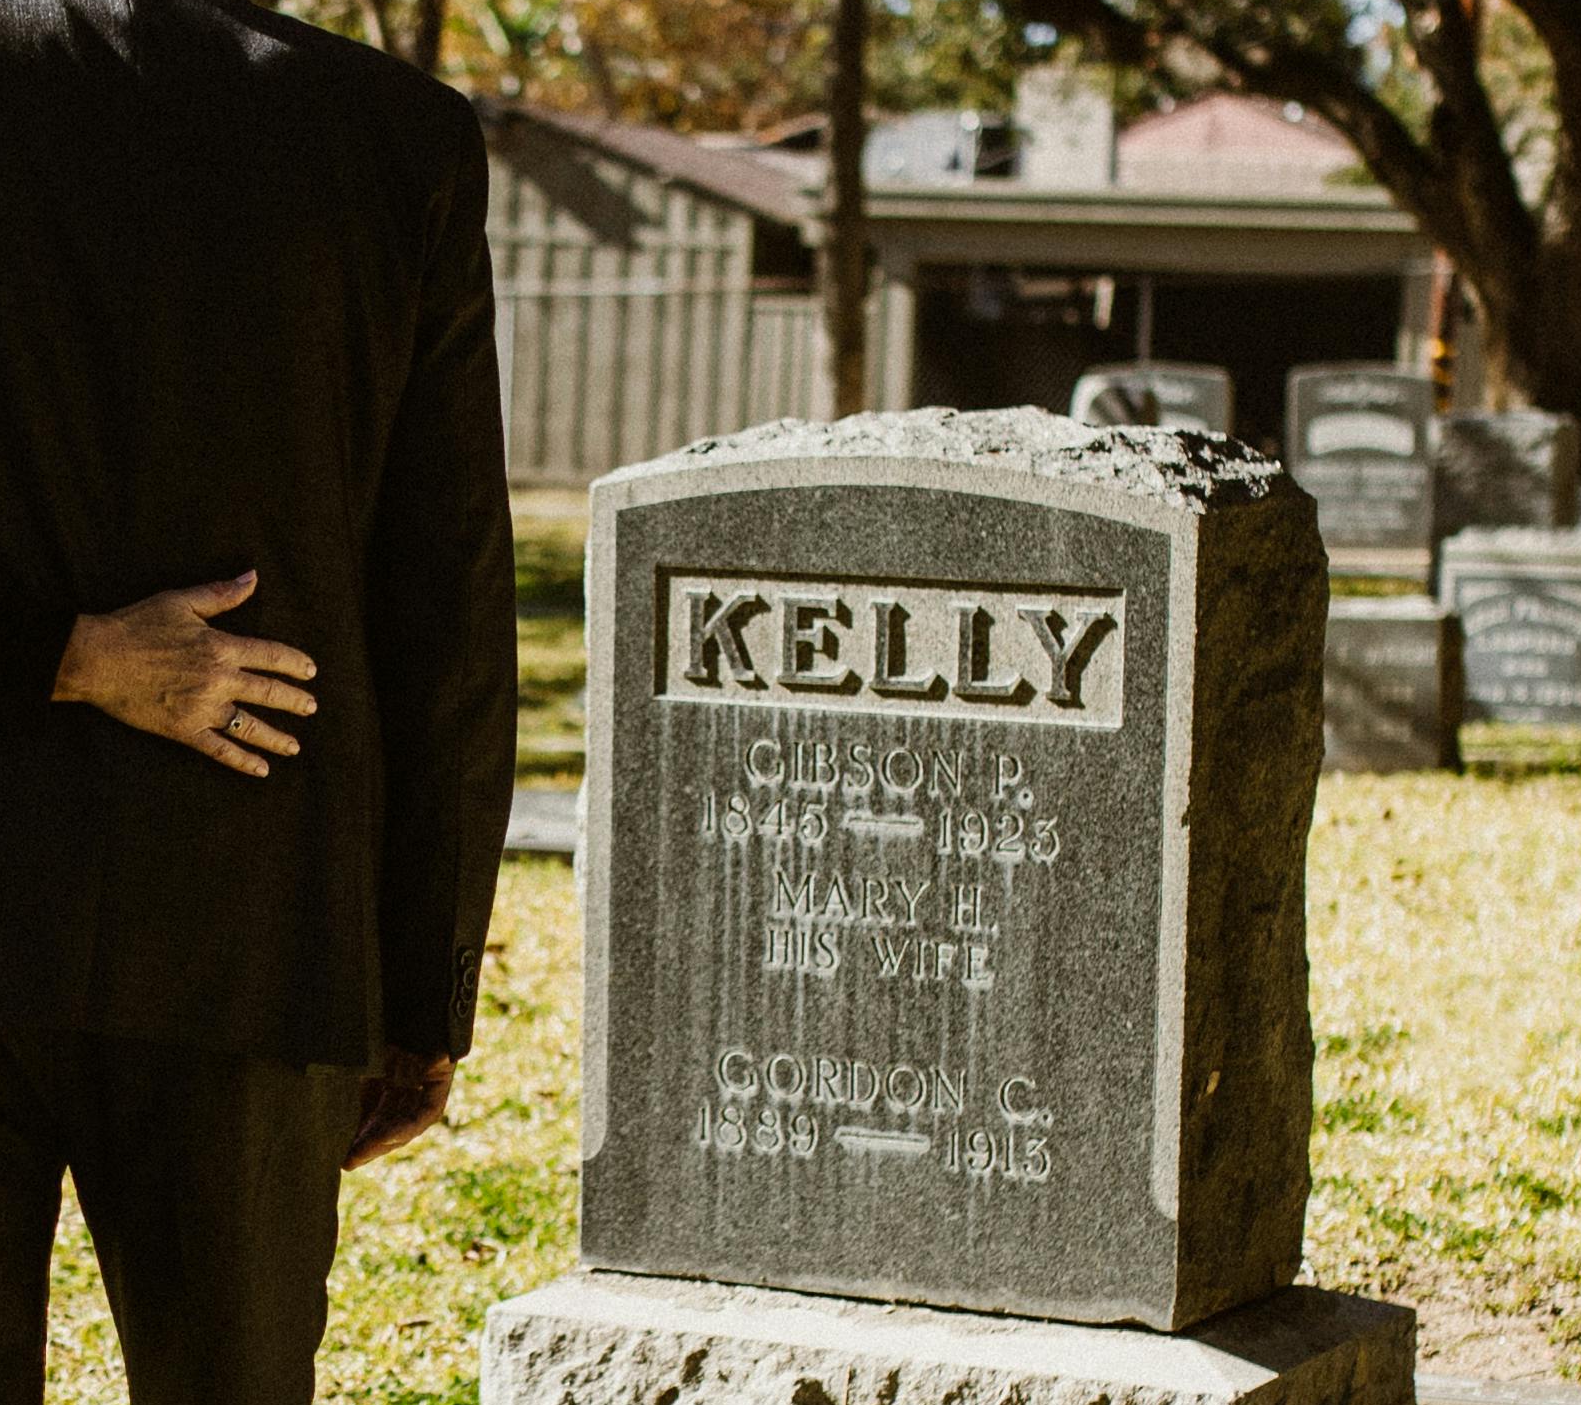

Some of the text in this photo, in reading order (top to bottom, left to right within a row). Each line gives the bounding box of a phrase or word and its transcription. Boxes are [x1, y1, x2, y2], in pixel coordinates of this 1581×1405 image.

[683, 588, 1117, 709] KELLY
[745, 737, 1034, 809] GIBSON P.
[701, 791, 828, 844] 1845
[939, 808, 1061, 862] 1923
[774, 866, 931, 925] MARY
[766, 928, 994, 983] HIS WIFE
[717, 1049, 1053, 1128] GORDON C.
[698, 1101, 819, 1157] 1889
[945, 1127, 1053, 1179] 1913
